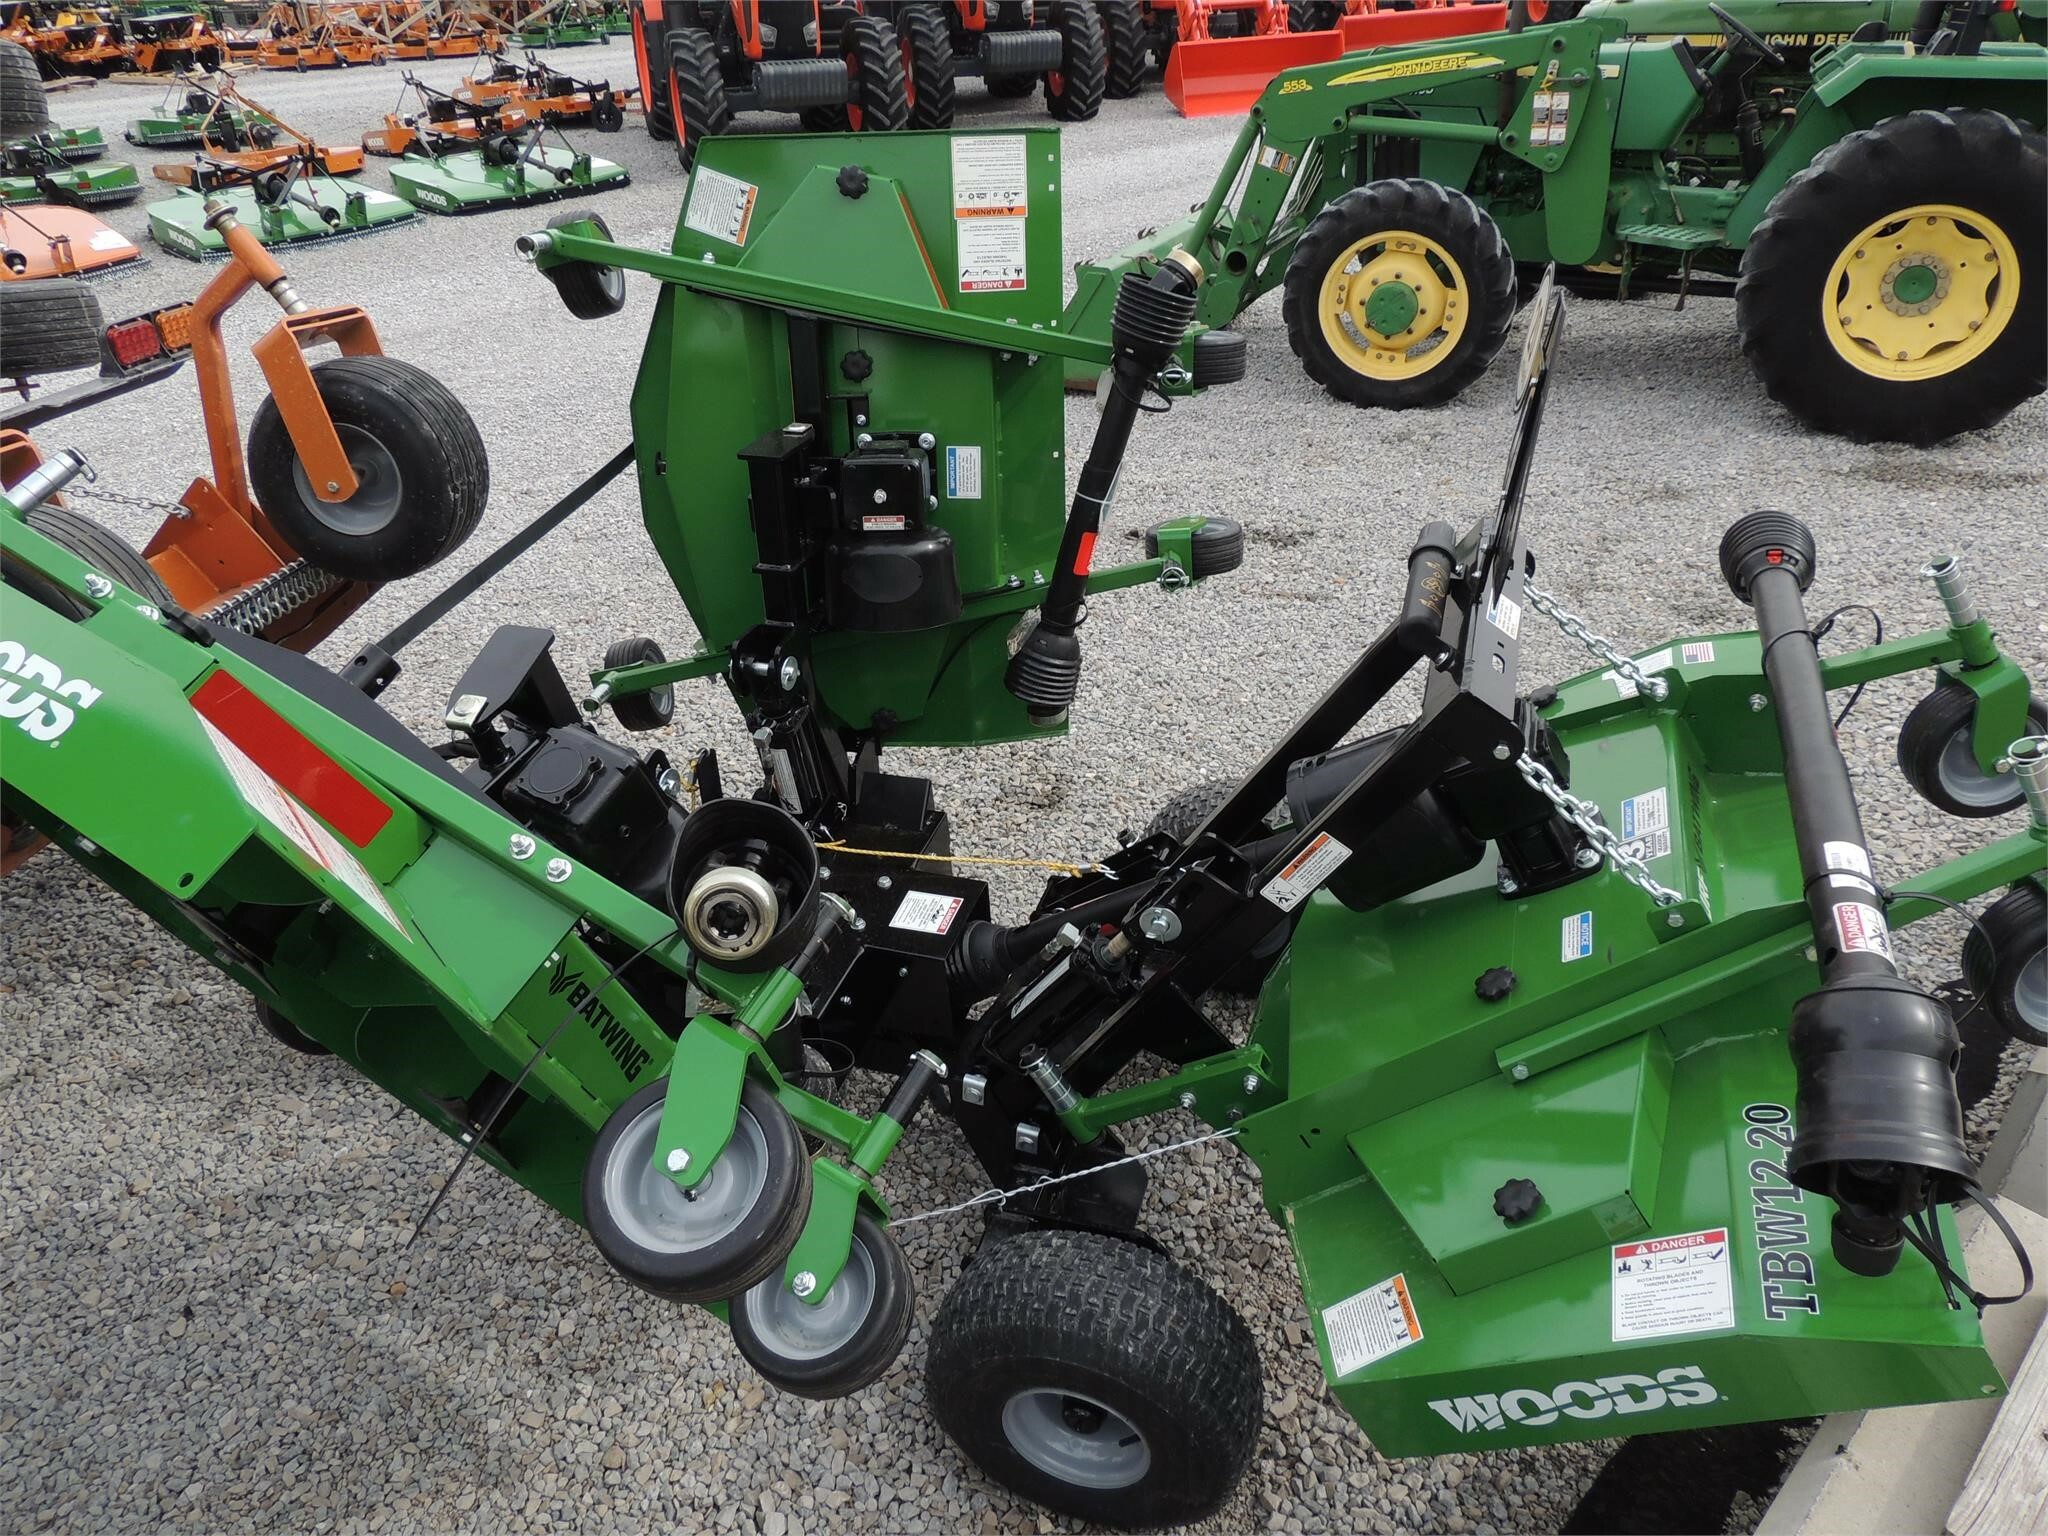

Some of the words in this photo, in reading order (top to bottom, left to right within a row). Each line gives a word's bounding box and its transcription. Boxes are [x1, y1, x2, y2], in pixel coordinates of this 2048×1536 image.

[1765, 33, 1808, 46] JOHN
[1814, 33, 1850, 46] DEE
[1386, 63, 1422, 77] JOHN
[1422, 56, 1468, 72] DEERE
[1283, 79, 1307, 93] 553
[415, 188, 448, 206] WOODS
[967, 208, 1005, 216] WARNING
[972, 281, 1005, 289] DANGER
[1842, 904, 1865, 938] DANGER
[566, 980, 652, 1083] BATWING
[1742, 1103, 1819, 1321] TBW1220
[1651, 1235, 1706, 1252] DANGER
[1427, 1365, 1718, 1434] WOODS
